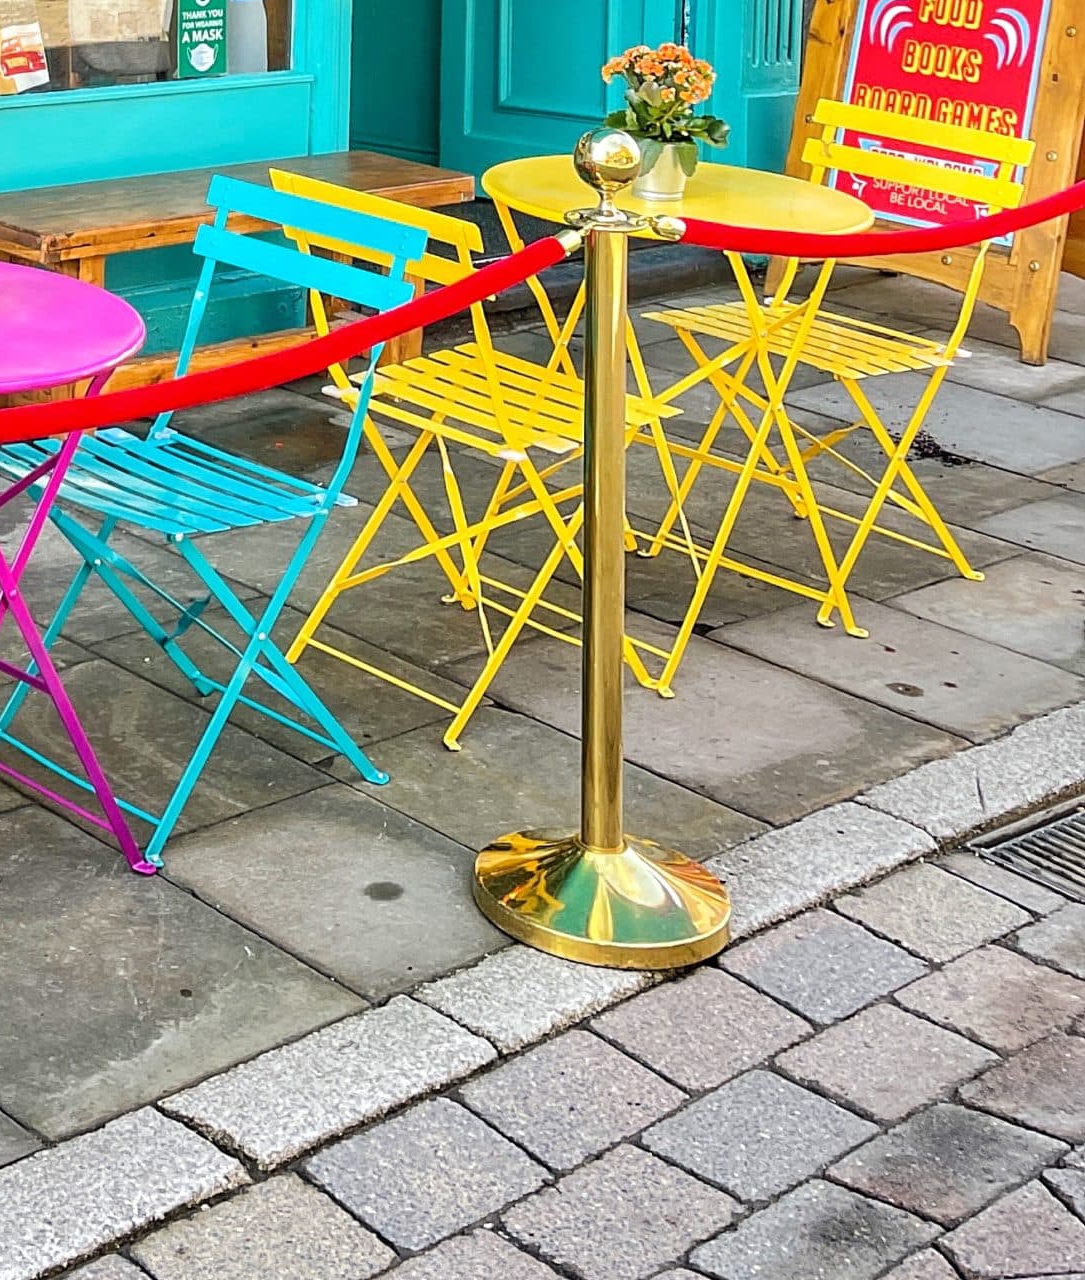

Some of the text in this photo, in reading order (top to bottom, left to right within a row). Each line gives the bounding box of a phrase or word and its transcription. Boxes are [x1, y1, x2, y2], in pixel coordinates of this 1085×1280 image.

[182, 9, 223, 20] THANK YOU
[182, 21, 194, 30] FOR
[181, 28, 223, 44] A MASK
[901, 38, 983, 84] BOOKS
[872, 177, 926, 197] SUPPORT
[889, 191, 948, 216] BE LOCAL
